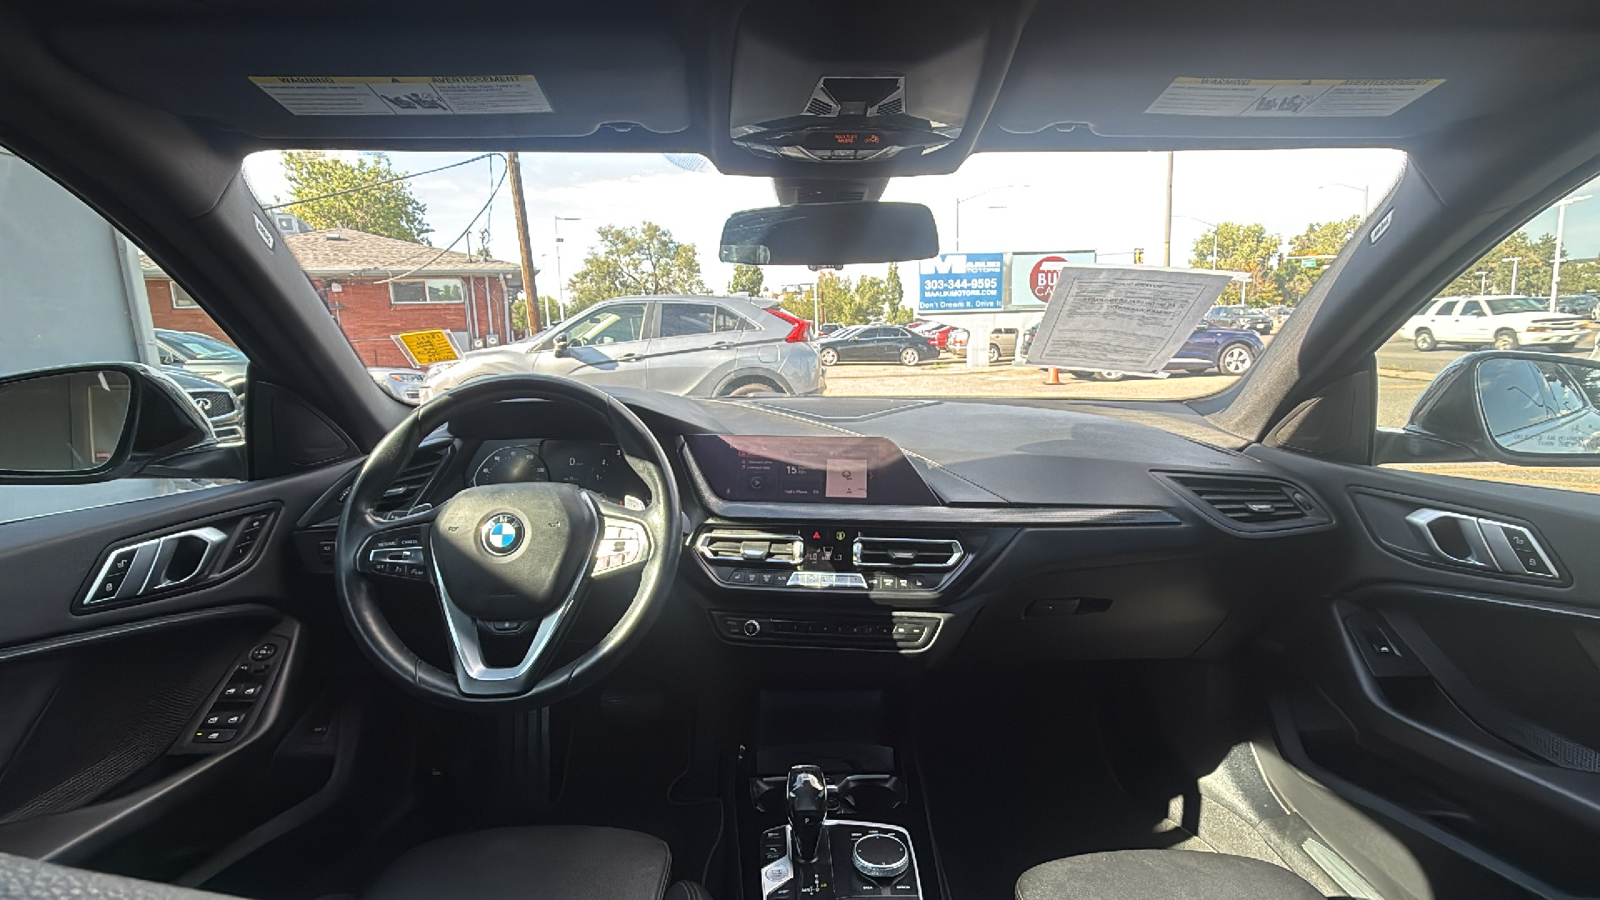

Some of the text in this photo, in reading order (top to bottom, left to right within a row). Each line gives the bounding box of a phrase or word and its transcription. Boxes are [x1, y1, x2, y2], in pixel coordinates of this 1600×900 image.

[924, 278, 998, 290] 303-344-9595
[1037, 272, 1060, 286] BU
[975, 300, 994, 308] Drive
[786, 465, 798, 474] 15
